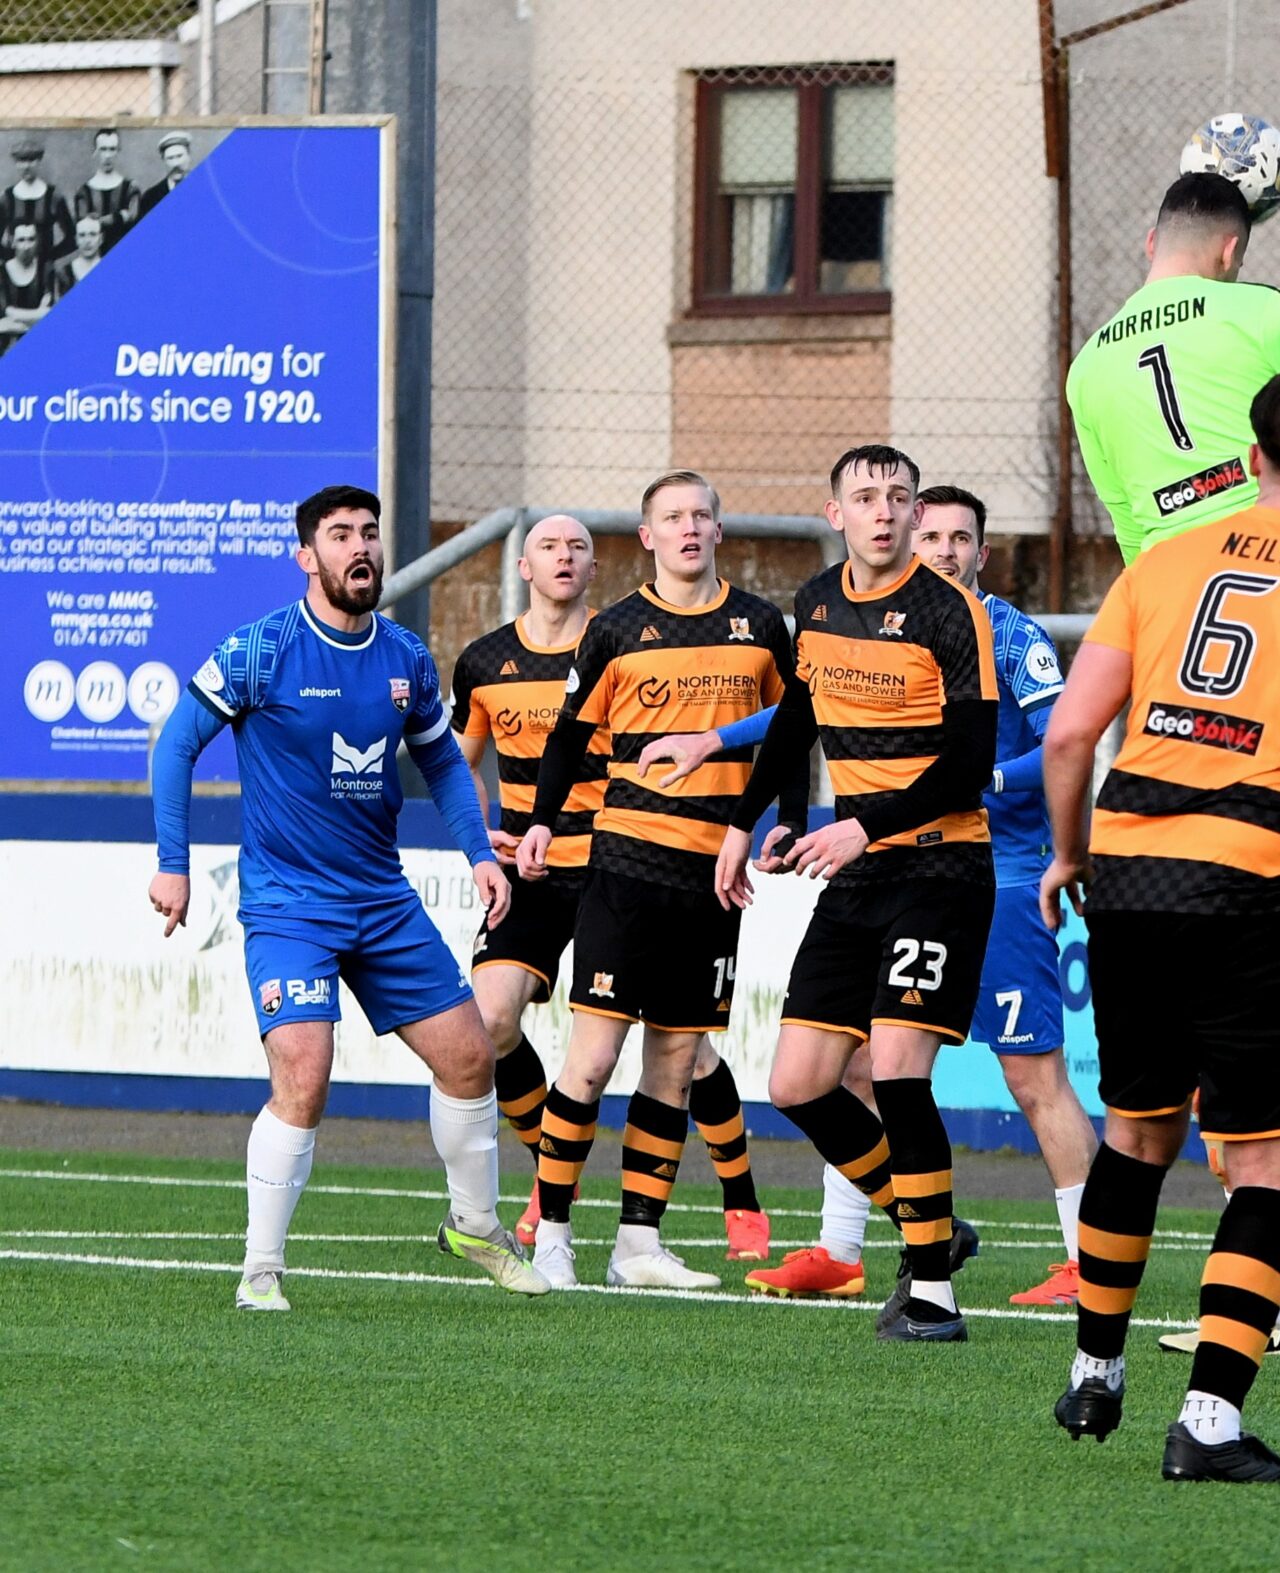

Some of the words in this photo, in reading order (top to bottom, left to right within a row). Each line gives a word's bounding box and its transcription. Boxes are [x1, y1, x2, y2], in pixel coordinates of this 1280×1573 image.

[1097, 296, 1206, 348] MORRISON
[115, 344, 272, 385] Delivering
[281, 344, 326, 379] for
[44, 388, 143, 423] clients
[150, 388, 232, 423] since
[243, 391, 322, 424] 1920.
[1136, 342, 1196, 454] 1
[1159, 463, 1245, 511] GeoSonic
[117, 499, 227, 521] accountancy
[229, 499, 262, 519] firm
[21, 518, 67, 536] value
[69, 518, 88, 536] of
[90, 518, 156, 540] building
[158, 518, 218, 541] trusting
[10, 536, 45, 555] and
[47, 538, 75, 555] our
[76, 536, 149, 558] strategic
[151, 536, 217, 556] mindset
[218, 537, 246, 556] will
[246, 537, 286, 559] help
[57, 553, 126, 574] achieve
[127, 555, 160, 574] real
[162, 556, 217, 574] results.
[46, 591, 75, 610] We
[77, 593, 106, 610] are
[677, 675, 757, 689] NORTHERN
[822, 665, 906, 687] NORTHERN
[299, 686, 342, 699] uhlsport
[677, 689, 698, 699] GAS
[700, 688, 724, 697] AND
[822, 680, 841, 690] GAS
[842, 682, 863, 693] AND
[865, 685, 906, 698] POWER
[1146, 708, 1258, 750] GeoSonic
[331, 777, 383, 791] Montrose
[887, 938, 949, 992] 23
[994, 989, 1023, 1036] 7
[997, 1033, 1035, 1045] uhlsport
